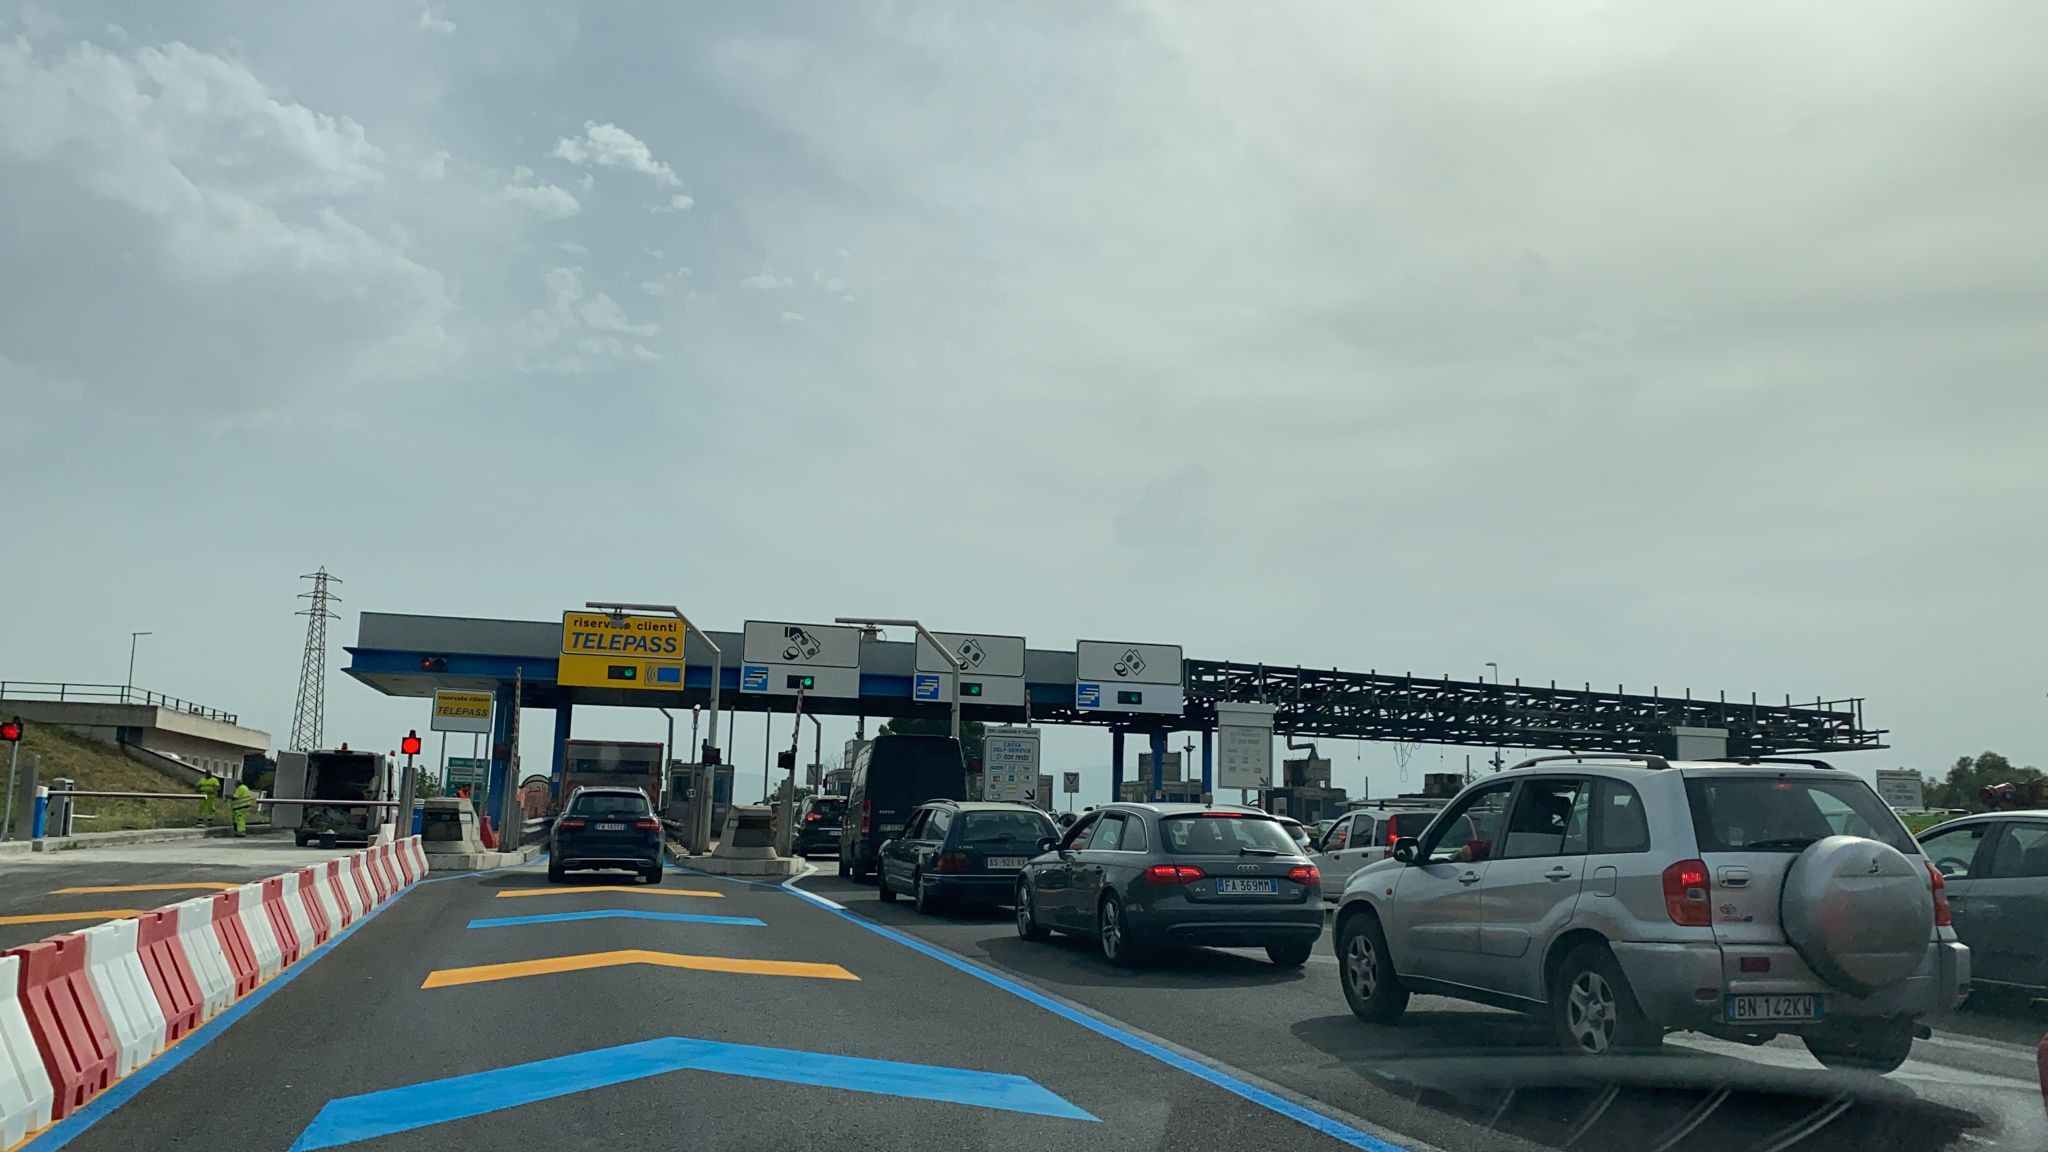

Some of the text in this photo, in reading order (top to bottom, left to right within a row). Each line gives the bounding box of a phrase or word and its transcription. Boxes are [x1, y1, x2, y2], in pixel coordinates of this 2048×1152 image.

[636, 621, 678, 632] clienti
[571, 631, 678, 653] TELEPASS
[438, 706, 489, 717] TELEPASS
[1239, 880, 1270, 891] 369MM
[1737, 998, 1813, 1017] BN 142KW
